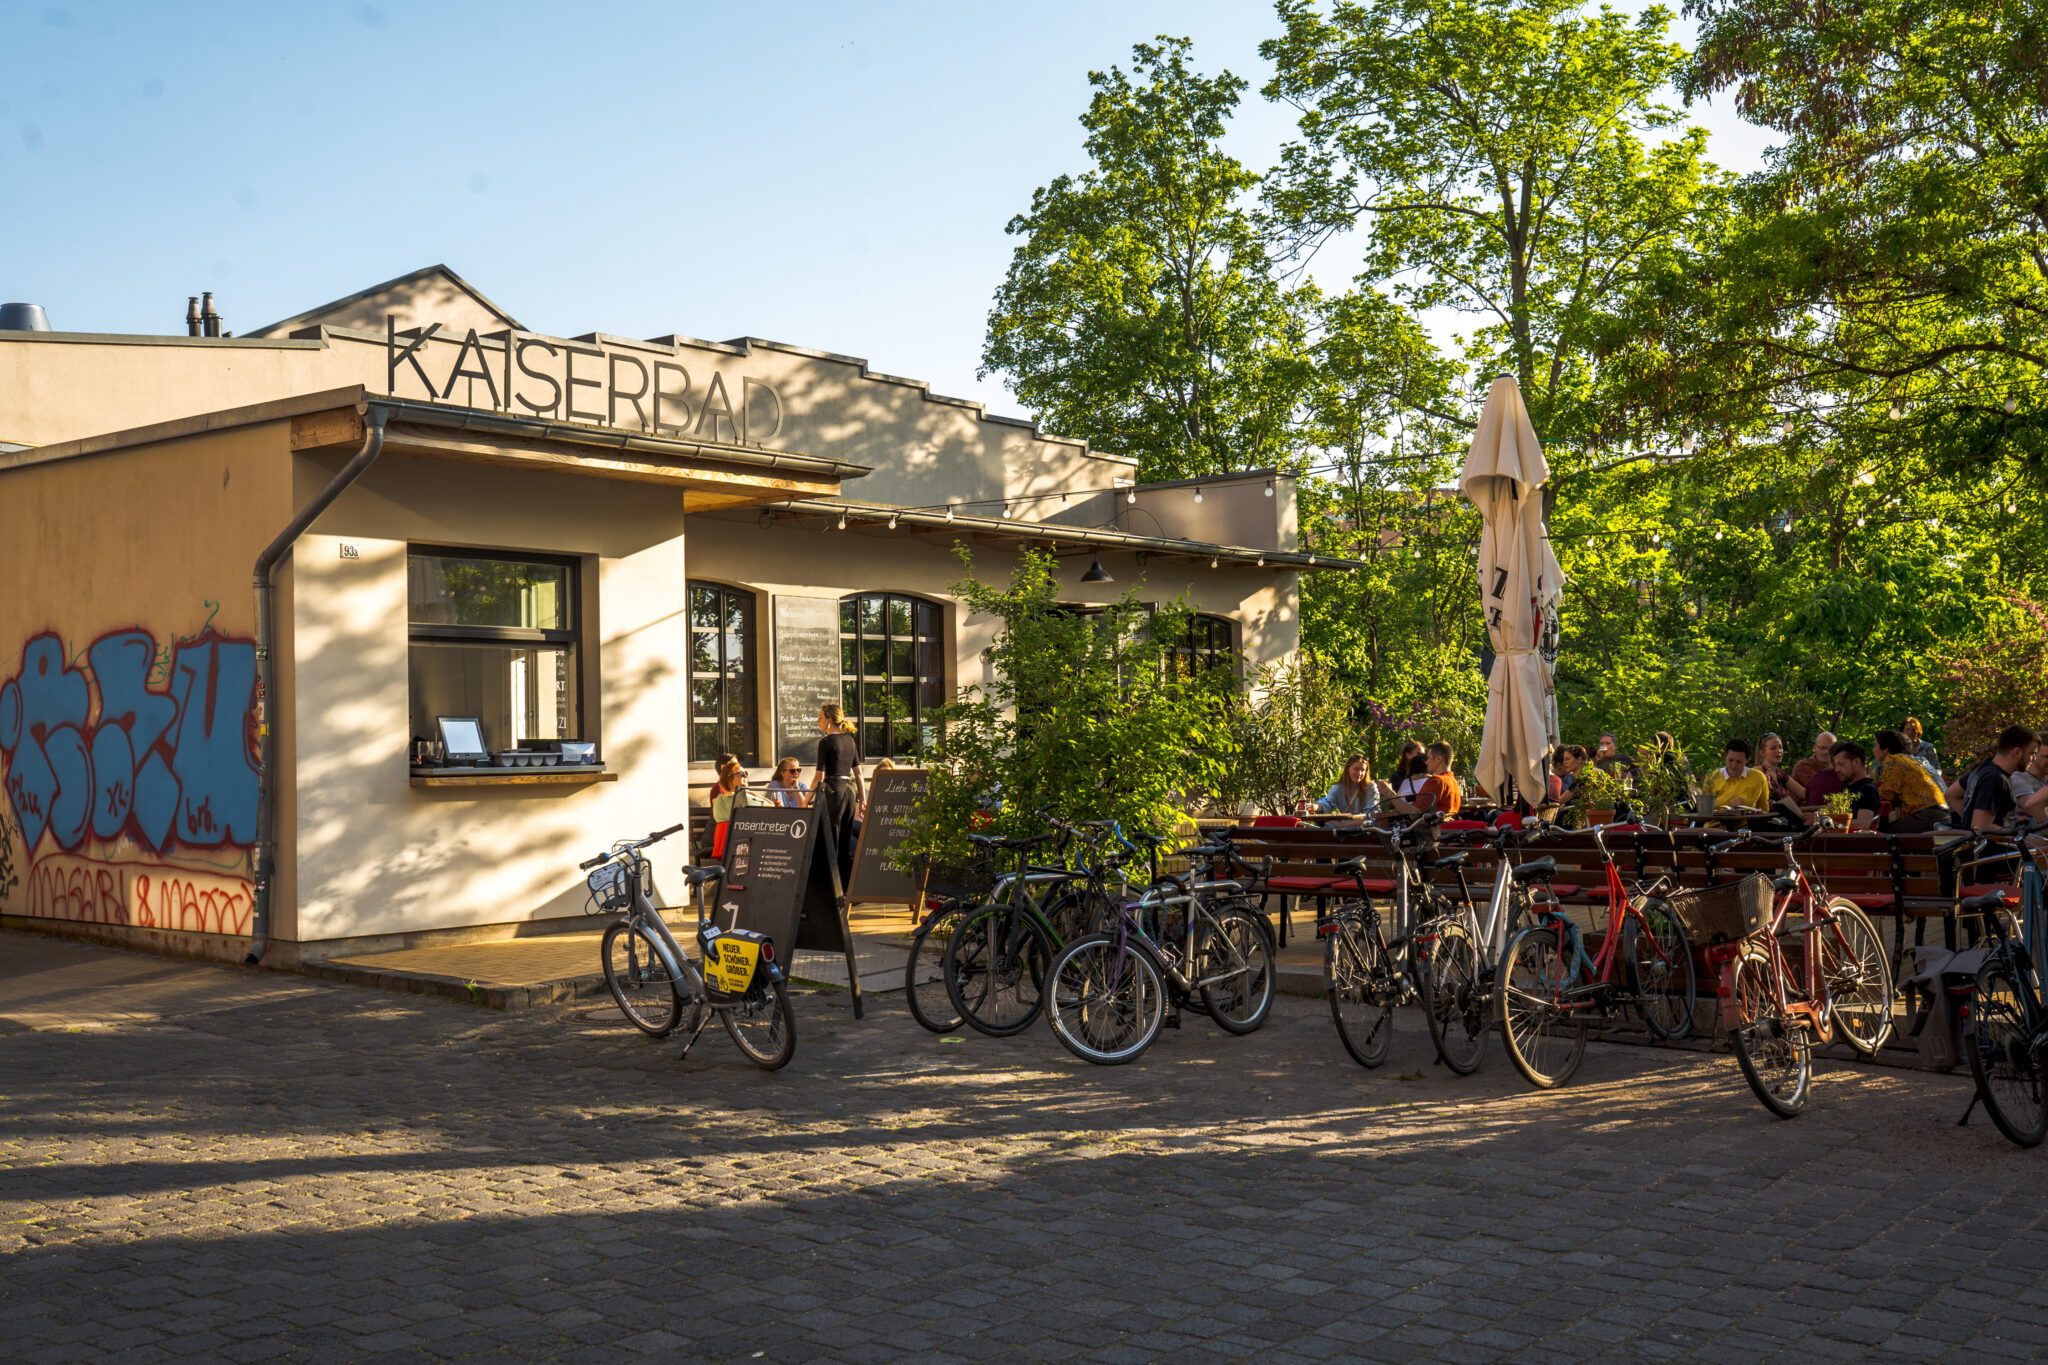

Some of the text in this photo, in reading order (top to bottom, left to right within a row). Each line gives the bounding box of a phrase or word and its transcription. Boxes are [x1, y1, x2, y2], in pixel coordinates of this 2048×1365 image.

[388, 314, 783, 442] KAISERBAD
[344, 545, 358, 557] 93a
[884, 778, 907, 793] Liebe
[875, 804, 888, 813] WIR
[734, 821, 790, 832] rosentreter
[722, 943, 743, 955] NEUER.
[723, 953, 752, 967] SCHÖNER.
